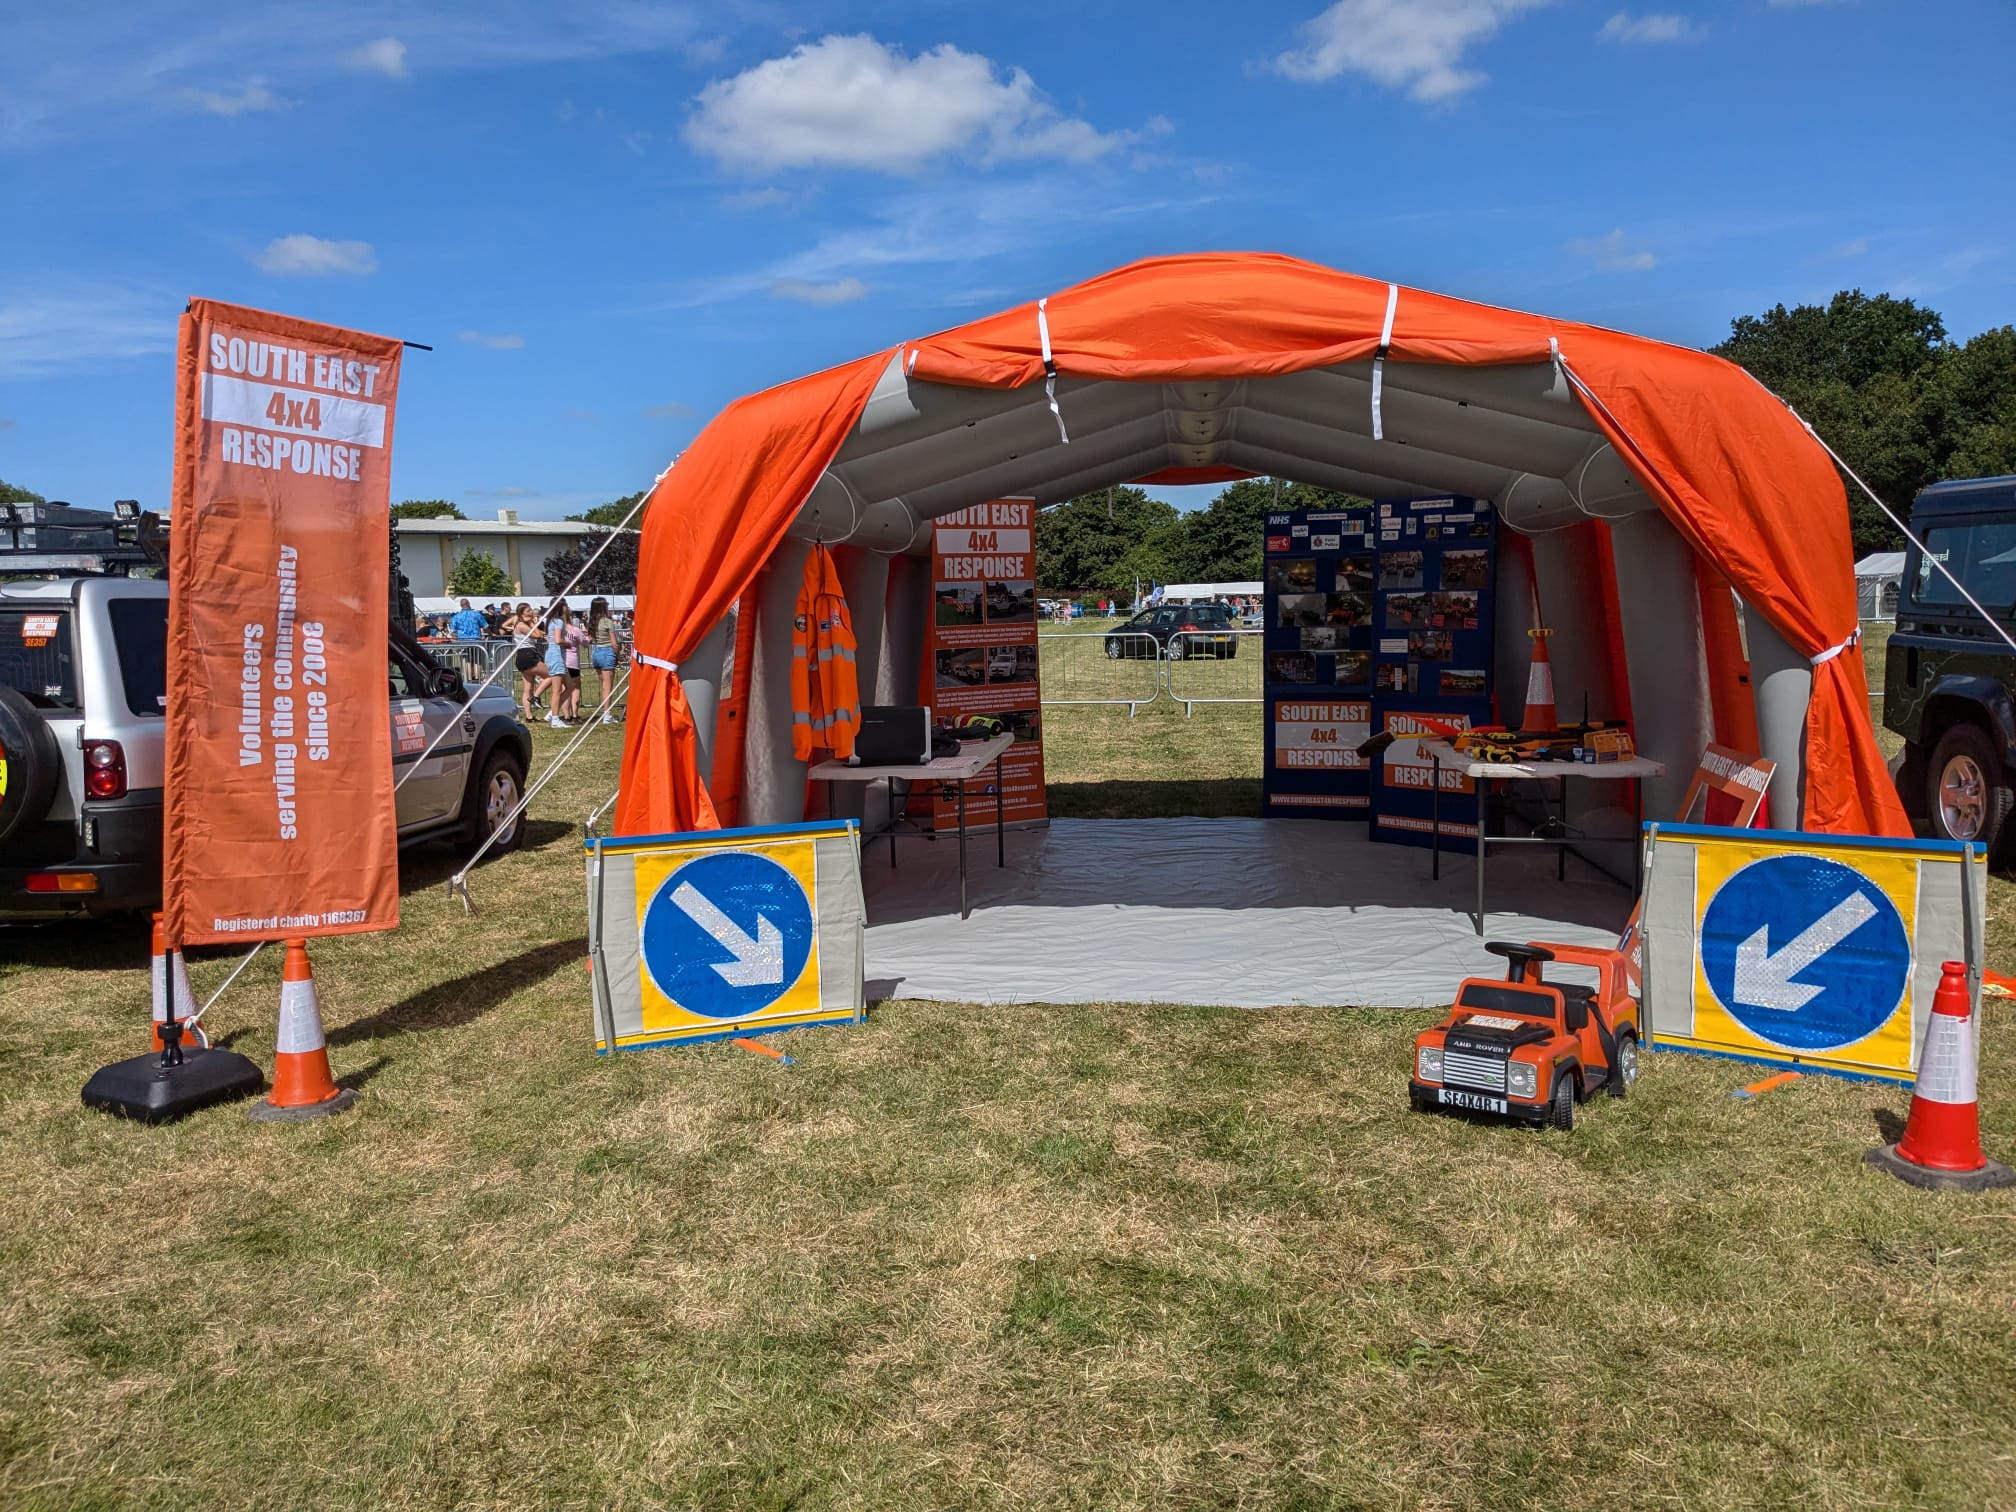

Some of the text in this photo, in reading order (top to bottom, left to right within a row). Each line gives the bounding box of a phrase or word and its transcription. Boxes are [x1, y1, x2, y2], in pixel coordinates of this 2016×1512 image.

[210, 333, 380, 397] SOUTH EAST
[266, 391, 321, 431] 4x4
[223, 428, 360, 481] RESPONSE
[992, 504, 1029, 526] EAST
[1269, 515, 1290, 525] NHS
[968, 531, 998, 551] 4x4
[944, 557, 1024, 578] RESPONSE
[239, 623, 264, 767] Volunteers
[270, 544, 298, 840] serving the community
[302, 622, 329, 761] since 2008
[1281, 705, 1368, 721] SOUTH EAST
[1311, 728, 1337, 743] 4x4
[1288, 750, 1360, 766] RESPONSE
[1416, 745, 1433, 760] 4x
[1394, 767, 1463, 789] RESPONSE
[214, 910, 366, 931] Registered charity 1168367
[1475, 1043, 1504, 1053] ROVER
